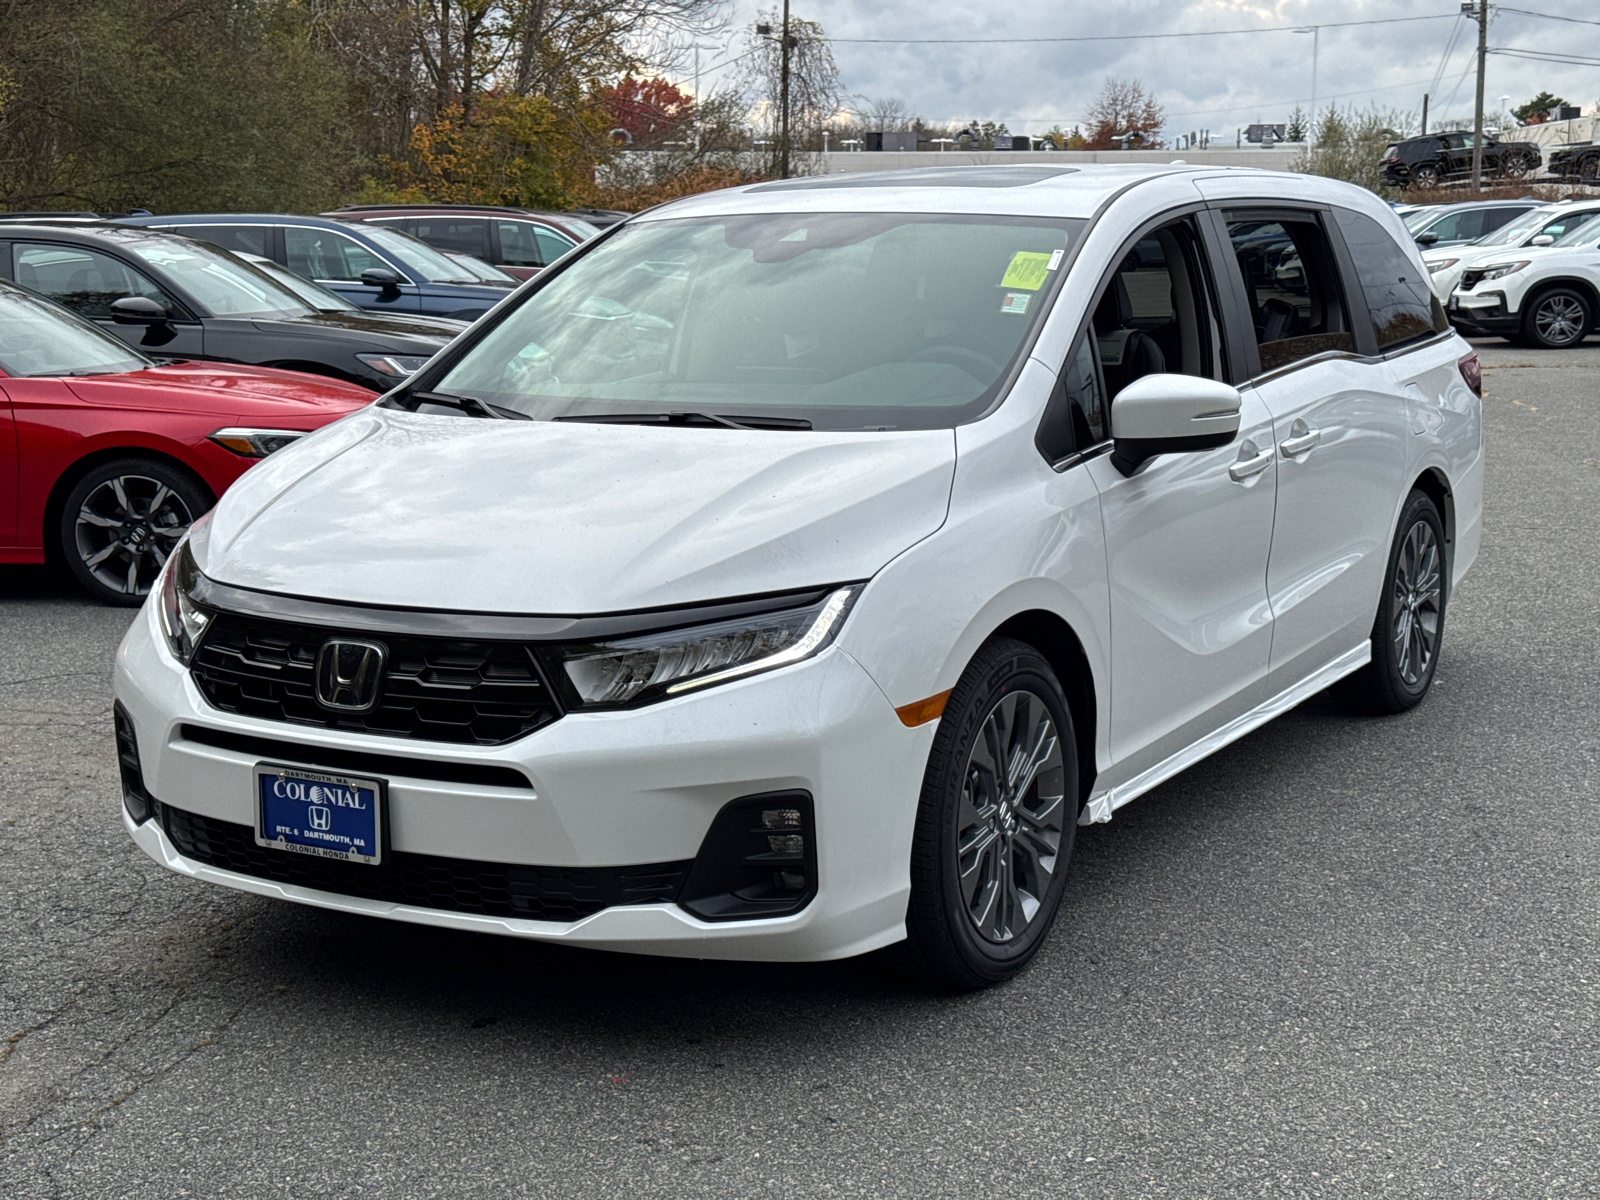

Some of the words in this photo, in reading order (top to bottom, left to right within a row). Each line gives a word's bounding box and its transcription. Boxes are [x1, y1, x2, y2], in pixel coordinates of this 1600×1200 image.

[285, 770, 335, 783] DARTMOUTH,
[336, 777, 349, 785] MA
[273, 780, 366, 810] COLONIAL
[276, 825, 293, 835] RTE.
[293, 828, 299, 836] 6
[303, 830, 352, 845] DARTMOUTH,
[353, 838, 365, 847] MA
[285, 843, 321, 856] COLONIAL
[322, 850, 349, 860] HONDA
